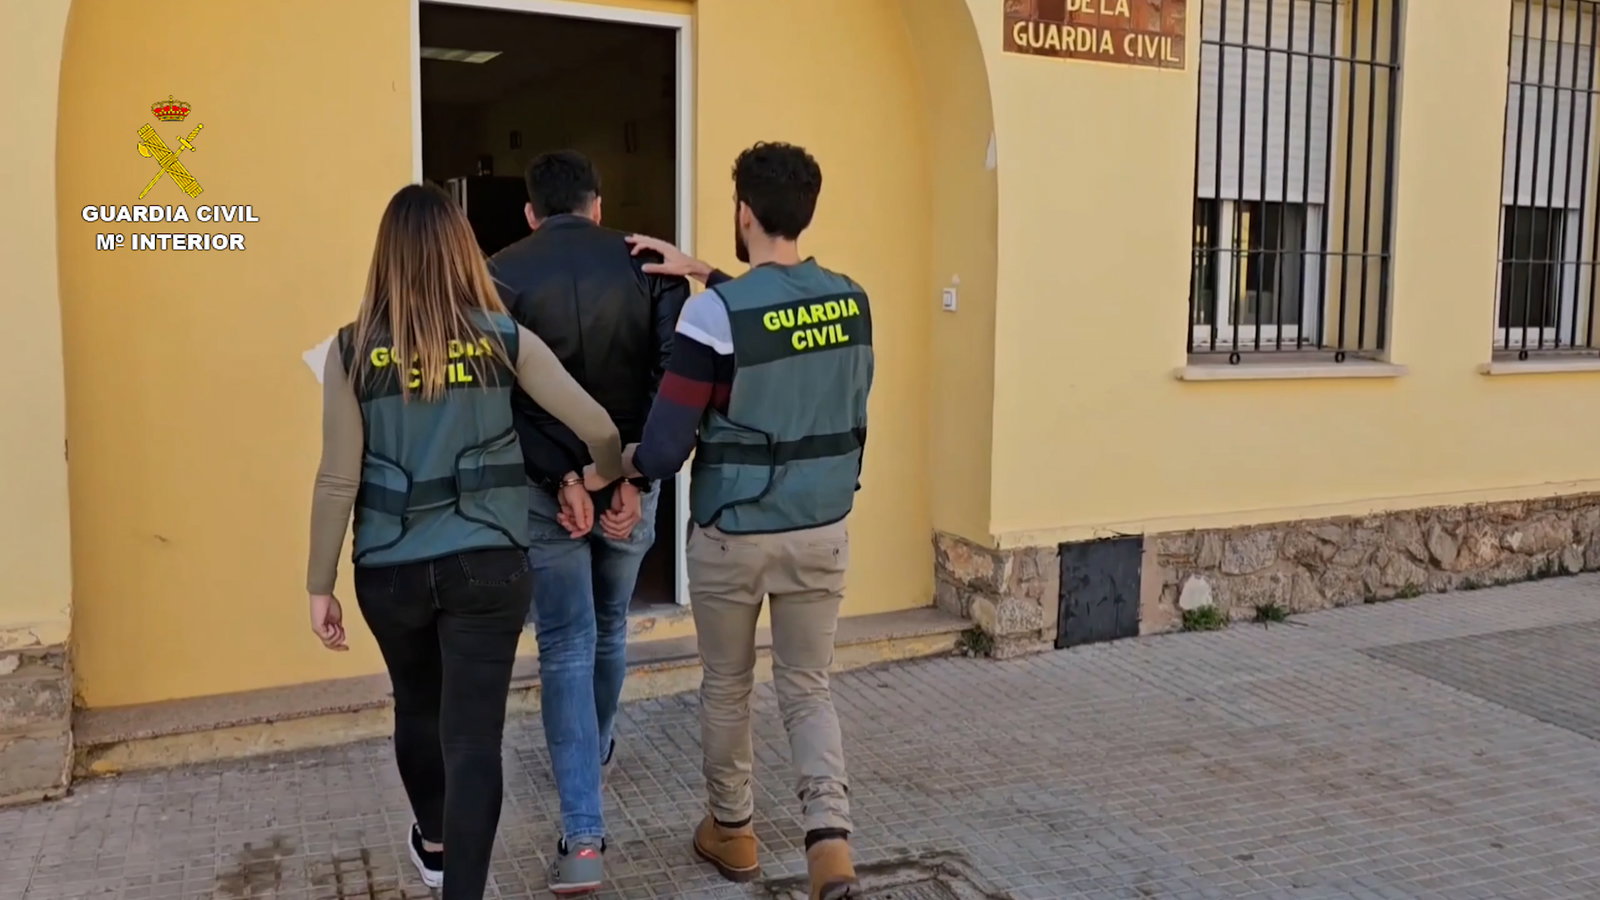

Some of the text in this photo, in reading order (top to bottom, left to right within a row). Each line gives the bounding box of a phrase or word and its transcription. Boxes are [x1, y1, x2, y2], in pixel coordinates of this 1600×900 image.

[1100, 0, 1130, 17] LA
[1013, 21, 1180, 62] GUARDIA CIVIL
[763, 298, 859, 331] GUARDIA
[791, 323, 850, 351] CIVIL
[406, 362, 473, 388] CIL
